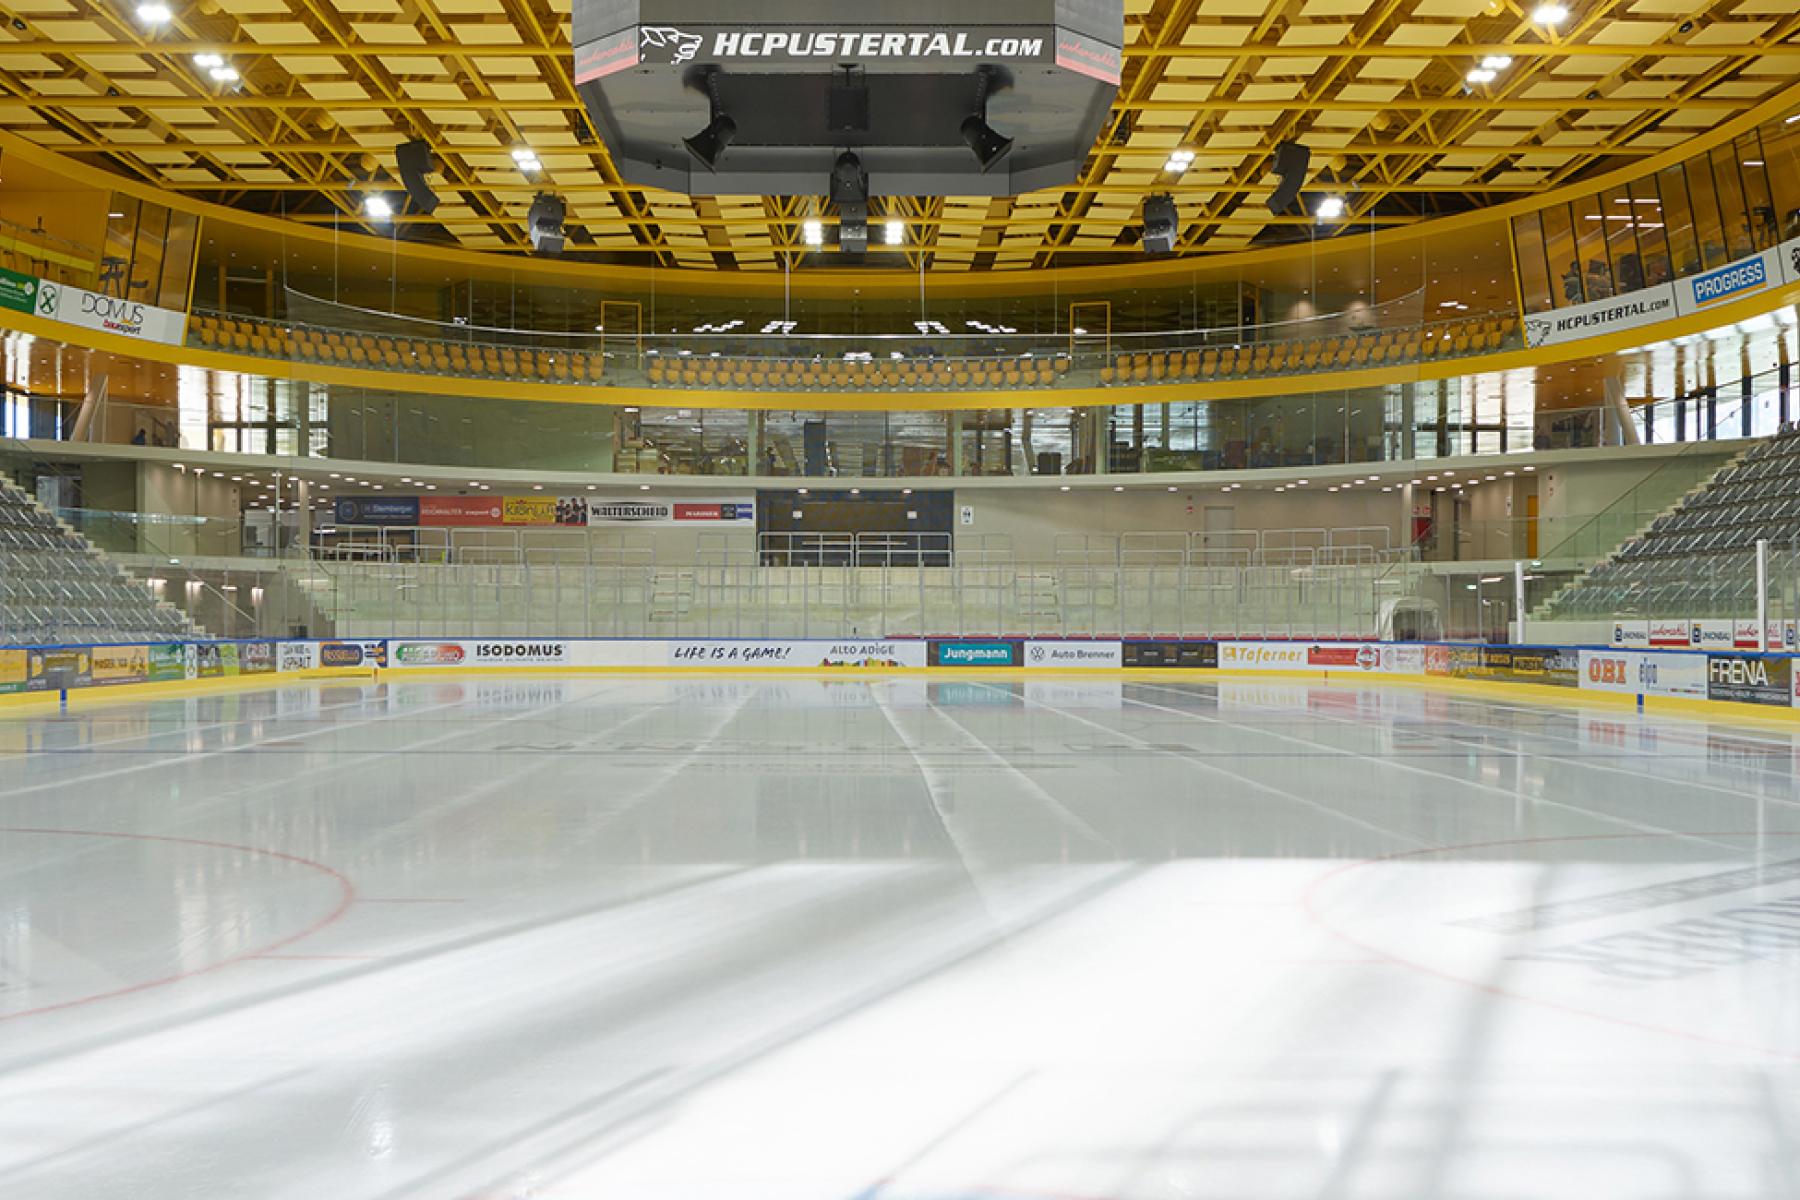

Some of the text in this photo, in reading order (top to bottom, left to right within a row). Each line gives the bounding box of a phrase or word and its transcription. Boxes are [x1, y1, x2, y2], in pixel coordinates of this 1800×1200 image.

[713, 32, 1043, 57] HCPUSTERTAL.COM
[1695, 262, 1763, 301] PROGRESS
[81, 293, 145, 325] DOMUS
[1556, 298, 1670, 331] HCPUSTERTAL.COM
[476, 644, 563, 657] ISODOMUS
[674, 646, 792, 662] LIFE IS A GAME!
[859, 642, 895, 655] ADIGE
[944, 647, 1008, 661] Jungmann
[1051, 650, 1076, 659] Auto
[1077, 650, 1115, 659] Brenner
[1239, 647, 1303, 664] Taferner
[1589, 658, 1627, 684] OBI
[1710, 658, 1768, 686] FRENA
